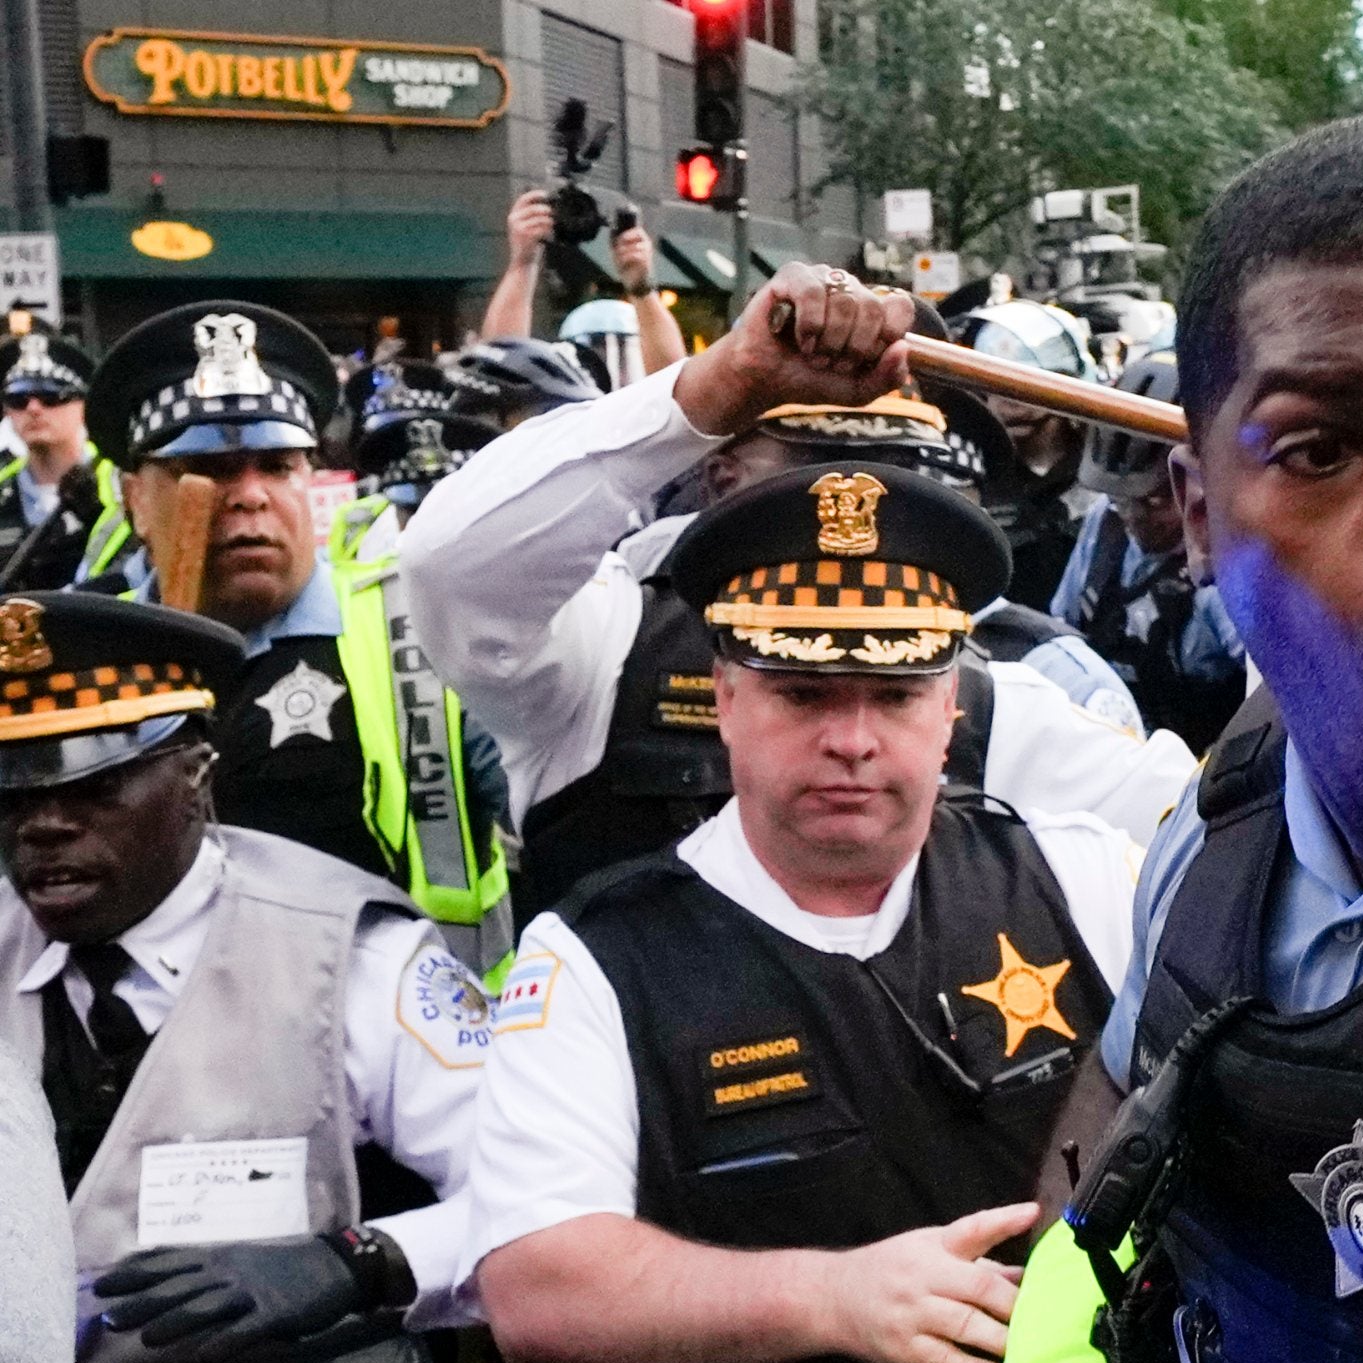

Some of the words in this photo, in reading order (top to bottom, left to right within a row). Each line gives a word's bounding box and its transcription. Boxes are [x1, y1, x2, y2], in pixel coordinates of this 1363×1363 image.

[135, 39, 359, 112] POTBELLY
[365, 56, 479, 86] SANDWICH
[710, 1036, 800, 1069] O'CONNOR
